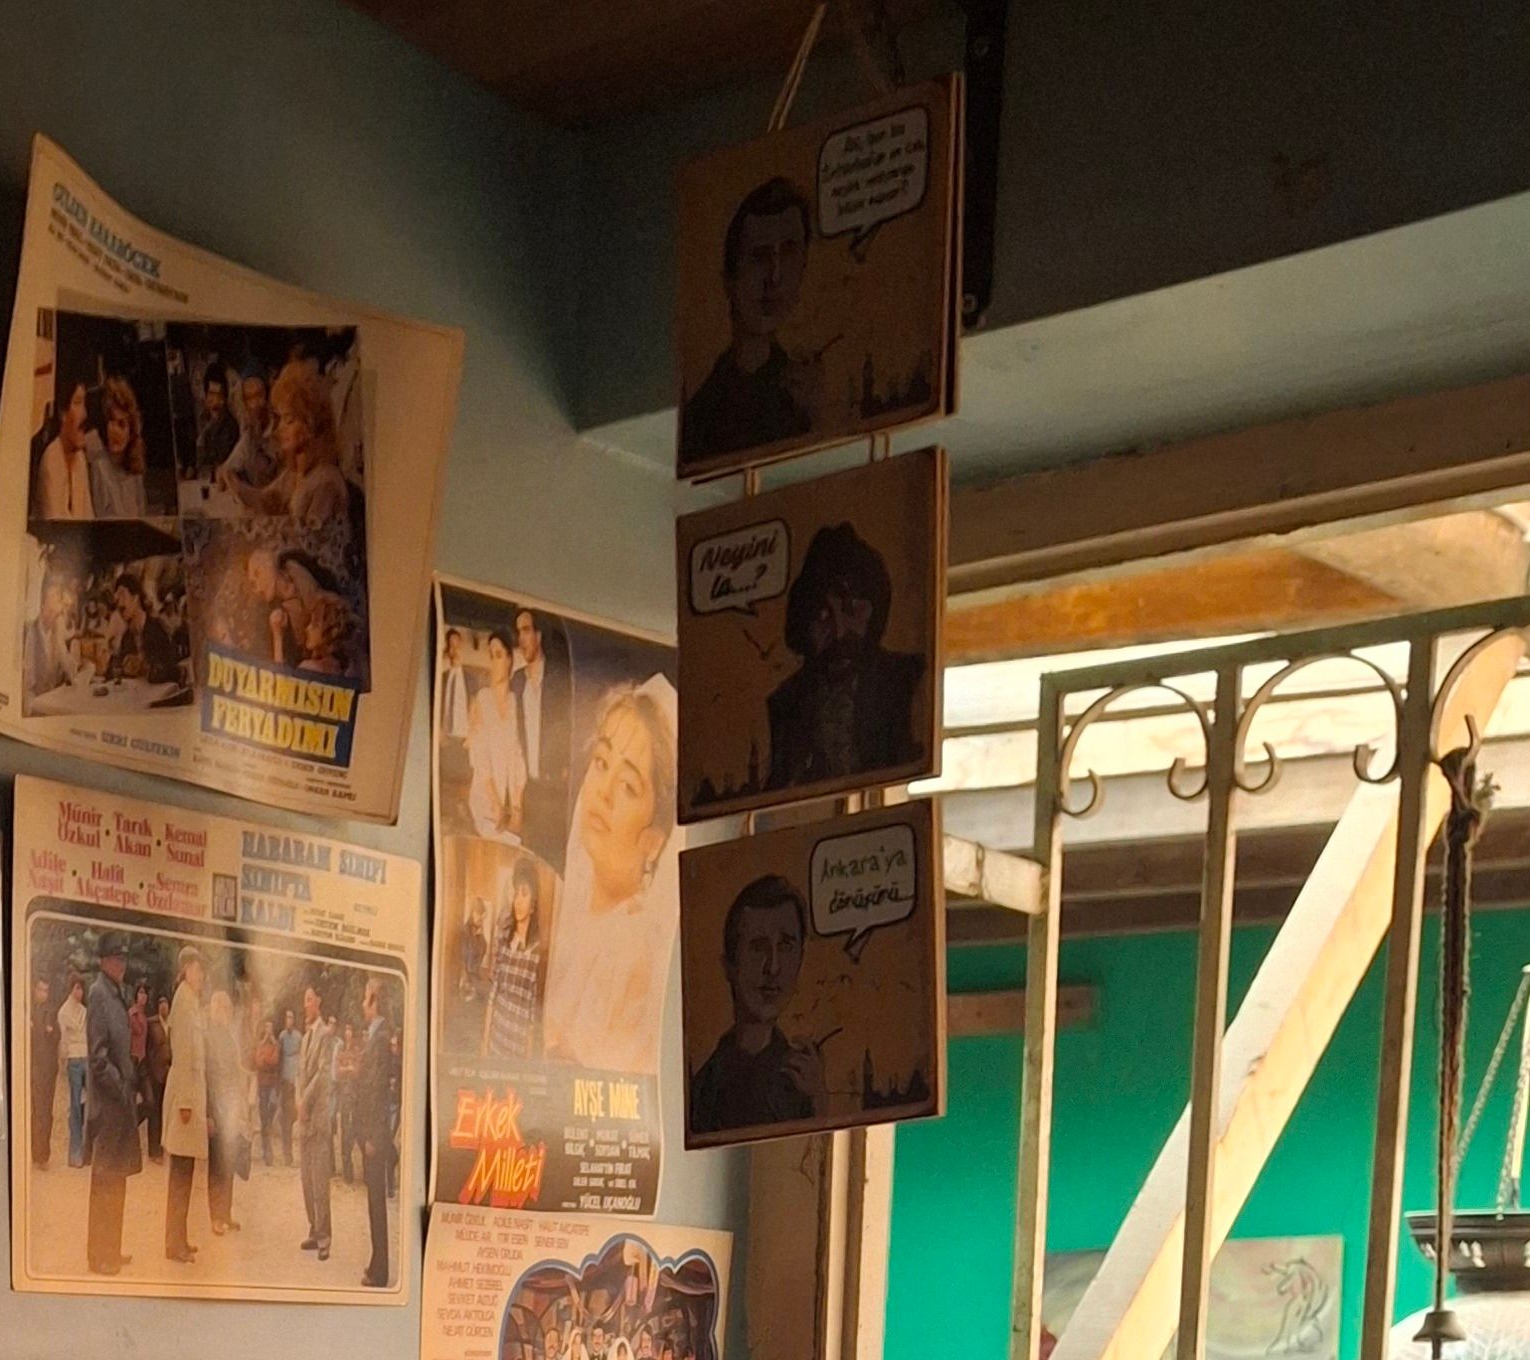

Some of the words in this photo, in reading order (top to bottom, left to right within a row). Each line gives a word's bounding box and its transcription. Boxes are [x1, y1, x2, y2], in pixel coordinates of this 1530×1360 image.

[699, 529, 777, 573] Neyini
[207, 651, 355, 723] DUYARMISIN
[210, 695, 338, 757] FERYADIMI
[58, 801, 103, 827] Münir
[114, 811, 153, 838] Tarık
[165, 823, 207, 848] Kemal
[114, 834, 152, 858] Akan
[167, 843, 205, 868] Sunal
[820, 846, 907, 885] Ankara'ya
[451, 1090, 522, 1142] Erkek
[573, 1079, 606, 1122] AYŞE
[609, 1077, 642, 1120] MİNE
[468, 1143, 547, 1193] Milleti
